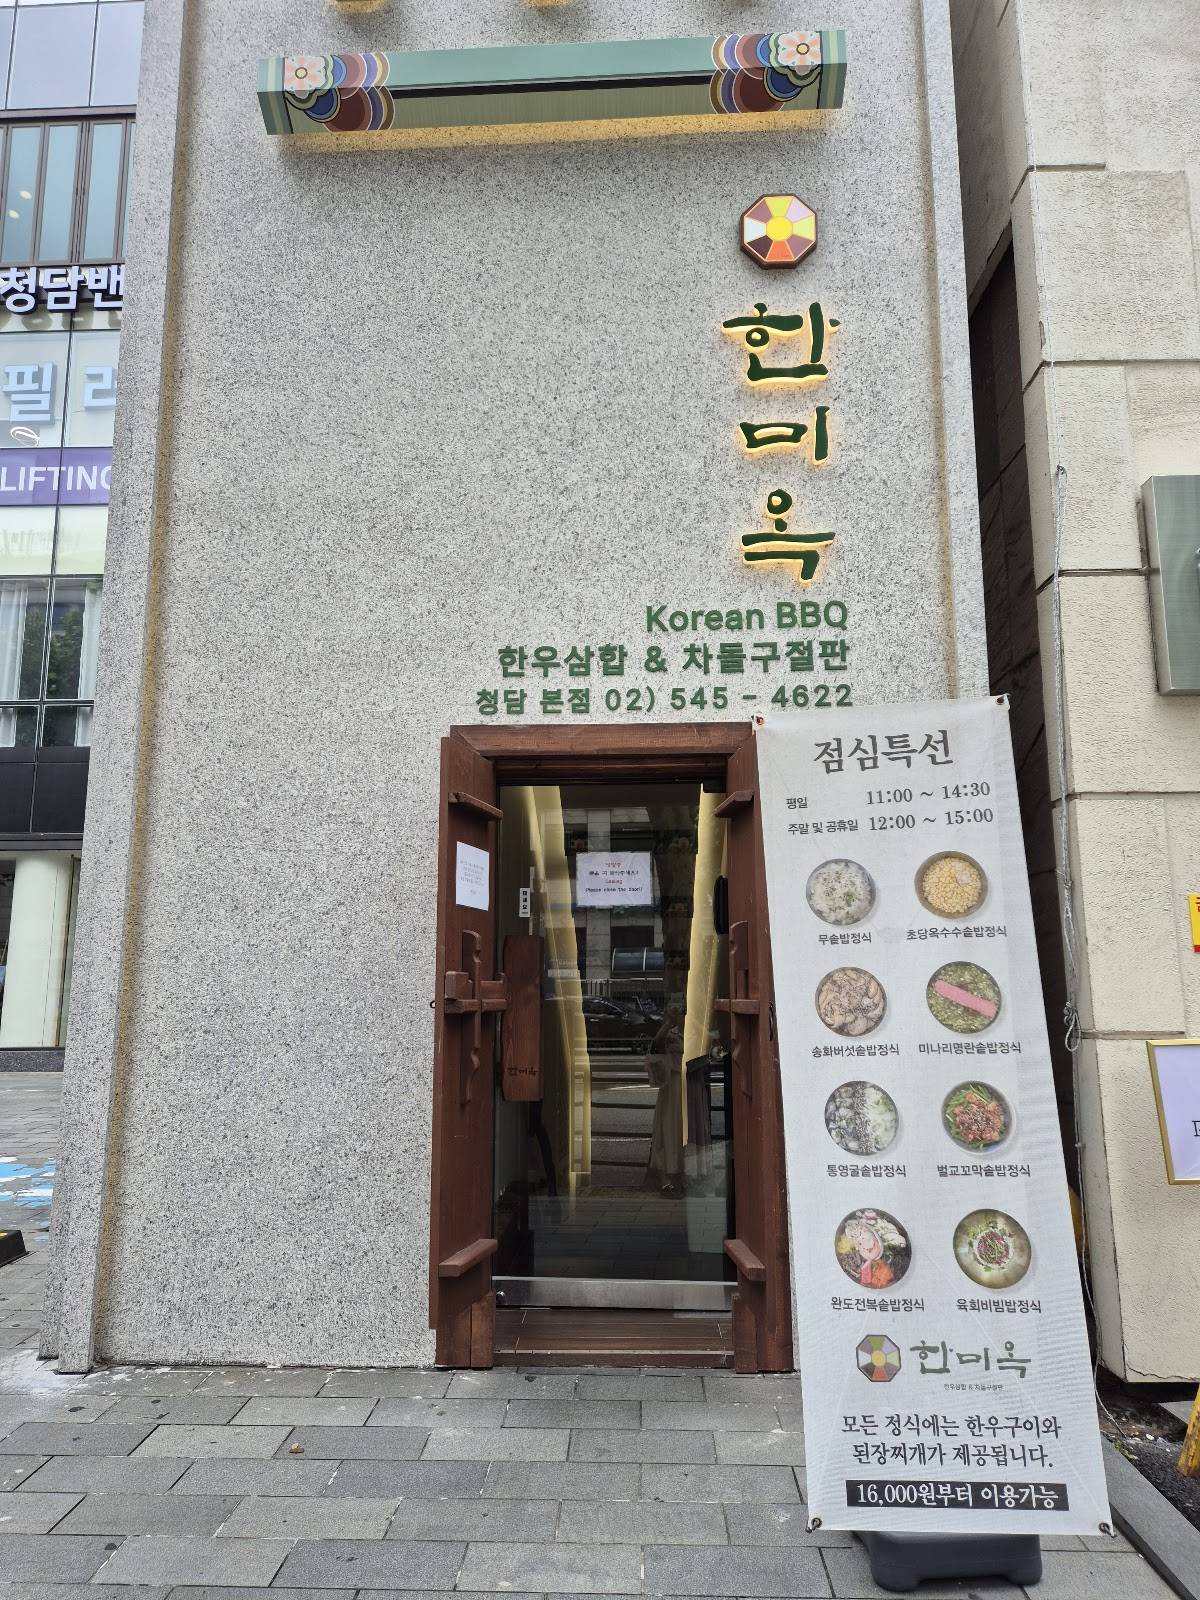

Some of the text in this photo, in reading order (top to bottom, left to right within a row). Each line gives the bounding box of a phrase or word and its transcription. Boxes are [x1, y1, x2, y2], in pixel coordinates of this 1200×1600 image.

[721, 302, 841, 582] 한미옥
[646, 600, 848, 632] Korean BBQ
[498, 638, 850, 678] 한우삼합 & 차돌구절판
[476, 688, 527, 715] 청담
[539, 687, 591, 715] 본점
[605, 686, 655, 712] 02)
[670, 686, 729, 711] 545
[771, 683, 853, 708] 4622
[813, 729, 954, 774] 점심특선
[786, 796, 809, 810] 평일
[866, 788, 913, 805] 11:00
[942, 781, 991, 800] 14:30
[788, 822, 809, 835] 주말
[812, 822, 823, 834] 및
[826, 819, 859, 833] 공휴일
[869, 814, 916, 831] 12:00
[945, 808, 994, 826] 15:00
[818, 932, 872, 945] 무솥밥정식
[906, 925, 1008, 941] 초당옥수수솥밥정식
[918, 1041, 1022, 1055] 미나리명란솥밥정식
[826, 1164, 907, 1178] 통영굴솥밥정식
[936, 1164, 1031, 1178] 벌교꼬막솥밥정식
[831, 1296, 925, 1312] 완도전복솥밥정식
[956, 1297, 1042, 1314] 육회비빔밥정식
[909, 1340, 1032, 1379] 한미옥
[842, 1414, 1061, 1439] 모든 정식에는 한우구이와
[852, 1443, 1054, 1468] 된장찌개가 제공됩니다.
[856, 1483, 1059, 1509] 16,000원부터 이용가능
